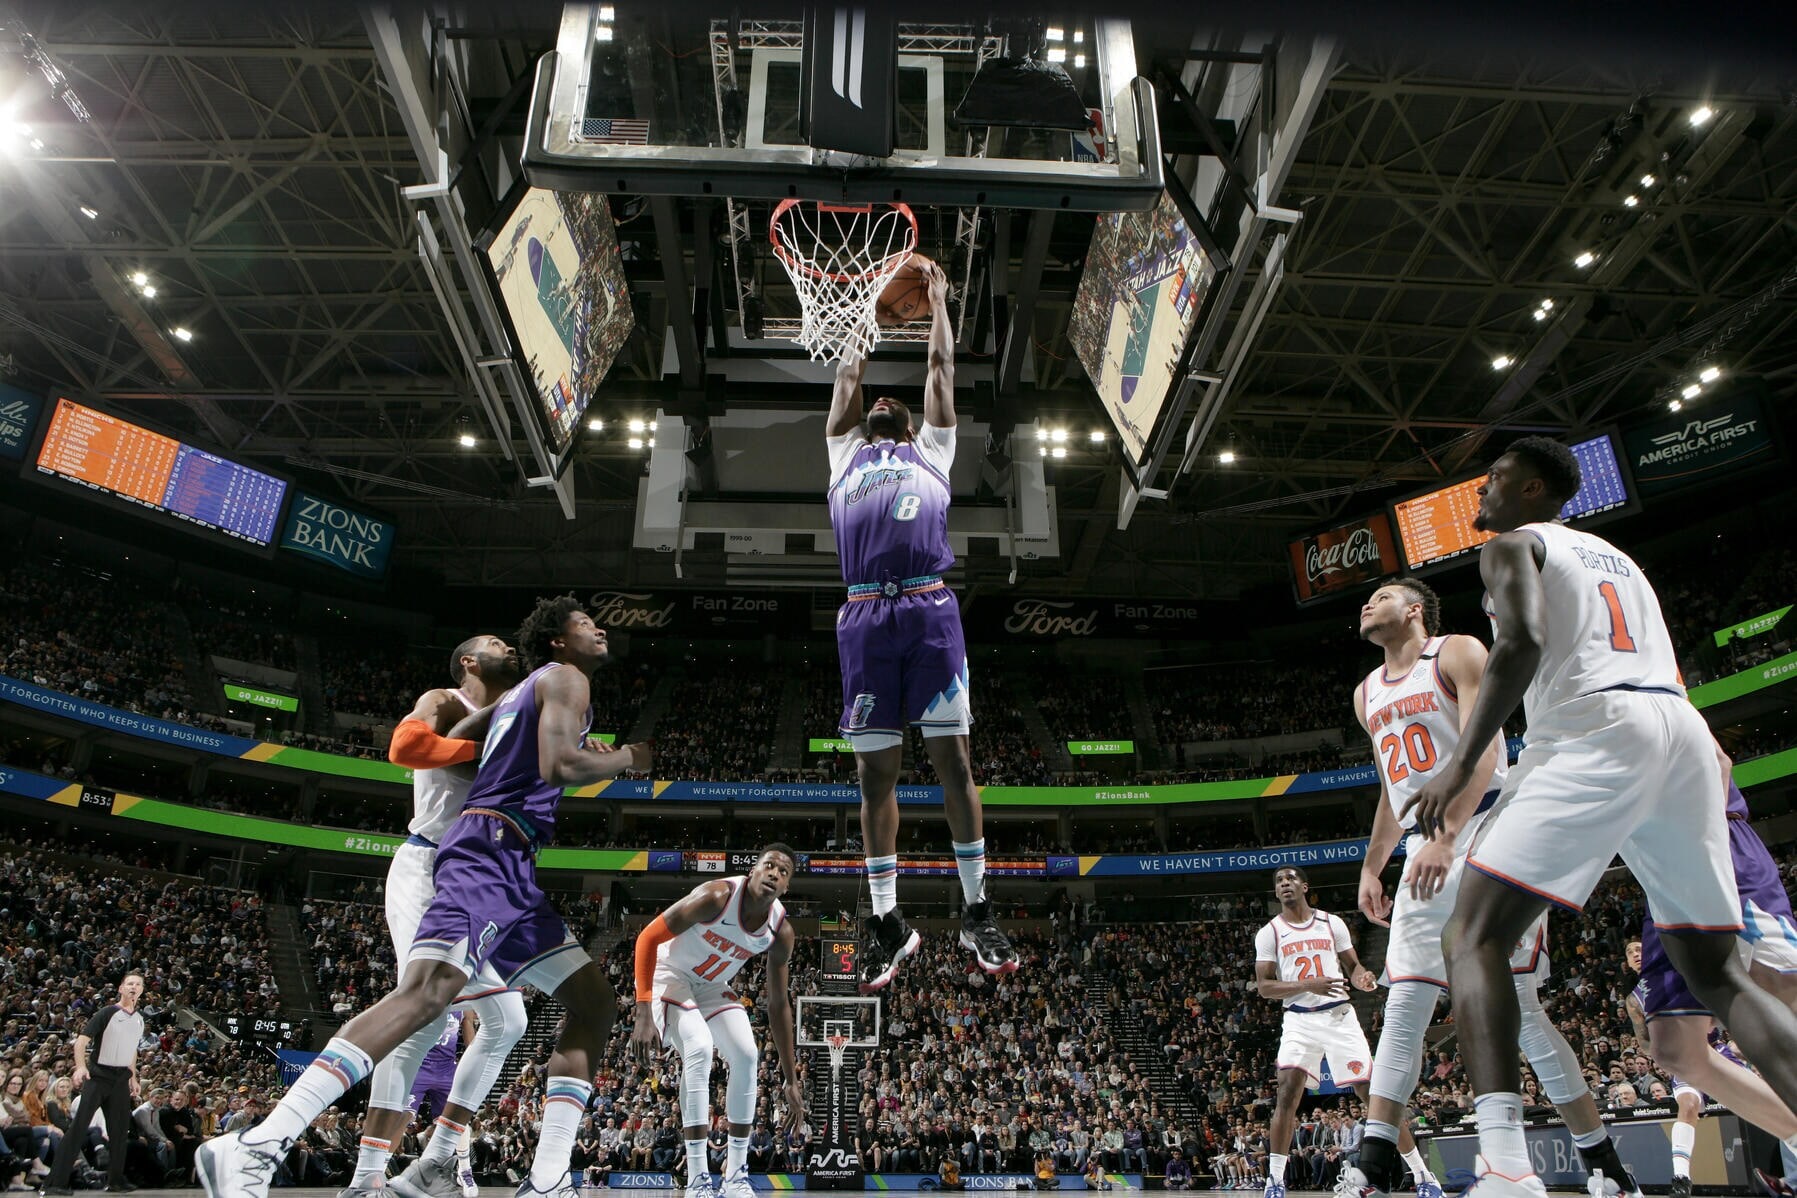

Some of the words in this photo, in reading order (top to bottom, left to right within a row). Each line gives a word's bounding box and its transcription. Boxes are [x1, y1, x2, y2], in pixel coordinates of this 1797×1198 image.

[1640, 438, 1708, 466] AMERICA
[1710, 420, 1757, 444] FIRST
[1666, 452, 1698, 464] CREDIT
[1704, 442, 1732, 454] UNION
[200, 453, 222, 464] JAZZ
[894, 492, 922, 522] 8
[298, 496, 382, 542] ZIONS
[291, 520, 374, 568] BANK
[1306, 528, 1380, 582] Coca-Cola
[1572, 546, 1630, 578] PORTIS
[590, 591, 676, 628] Ford
[692, 596, 728, 610] Fan
[732, 596, 778, 612] Zone
[1114, 604, 1148, 618] Fan
[1152, 604, 1198, 620] Zone
[1004, 598, 1099, 636] Ford
[1598, 580, 1638, 654] 1
[239, 692, 251, 700] GO
[10, 686, 76, 712] FORGOTTEN
[80, 706, 106, 720] WHO
[108, 714, 138, 729] KEEPS
[142, 722, 154, 732] US
[158, 726, 169, 736] IN
[1368, 704, 1396, 736] NEW
[1395, 691, 1439, 718] YORK
[1381, 722, 1438, 786] 20
[1321, 776, 1336, 784] WE
[1338, 770, 1376, 782] HAVEN'T
[82, 792, 106, 806] 8:53
[748, 788, 804, 797] FORGOTTEN
[344, 837, 400, 853] #Zions
[732, 855, 758, 864] 8:45
[1140, 860, 1160, 870] WE
[1166, 858, 1223, 870] HAVEN'T
[1229, 850, 1318, 866] FORGOTTEN
[1323, 846, 1358, 859] WHO
[702, 929, 732, 953] NEW
[832, 944, 854, 954] 8:45
[1281, 940, 1304, 958] NEW
[1304, 938, 1332, 952] YORK
[692, 954, 732, 982] 11
[840, 954, 852, 972] 5
[1294, 954, 1325, 980] 21
[229, 1026, 238, 1034] 78
[254, 1020, 276, 1032] 8:45
[621, 1175, 664, 1186] ZIONS
[963, 1177, 1004, 1188] ZIONS
[1009, 1177, 1034, 1188] BAN
